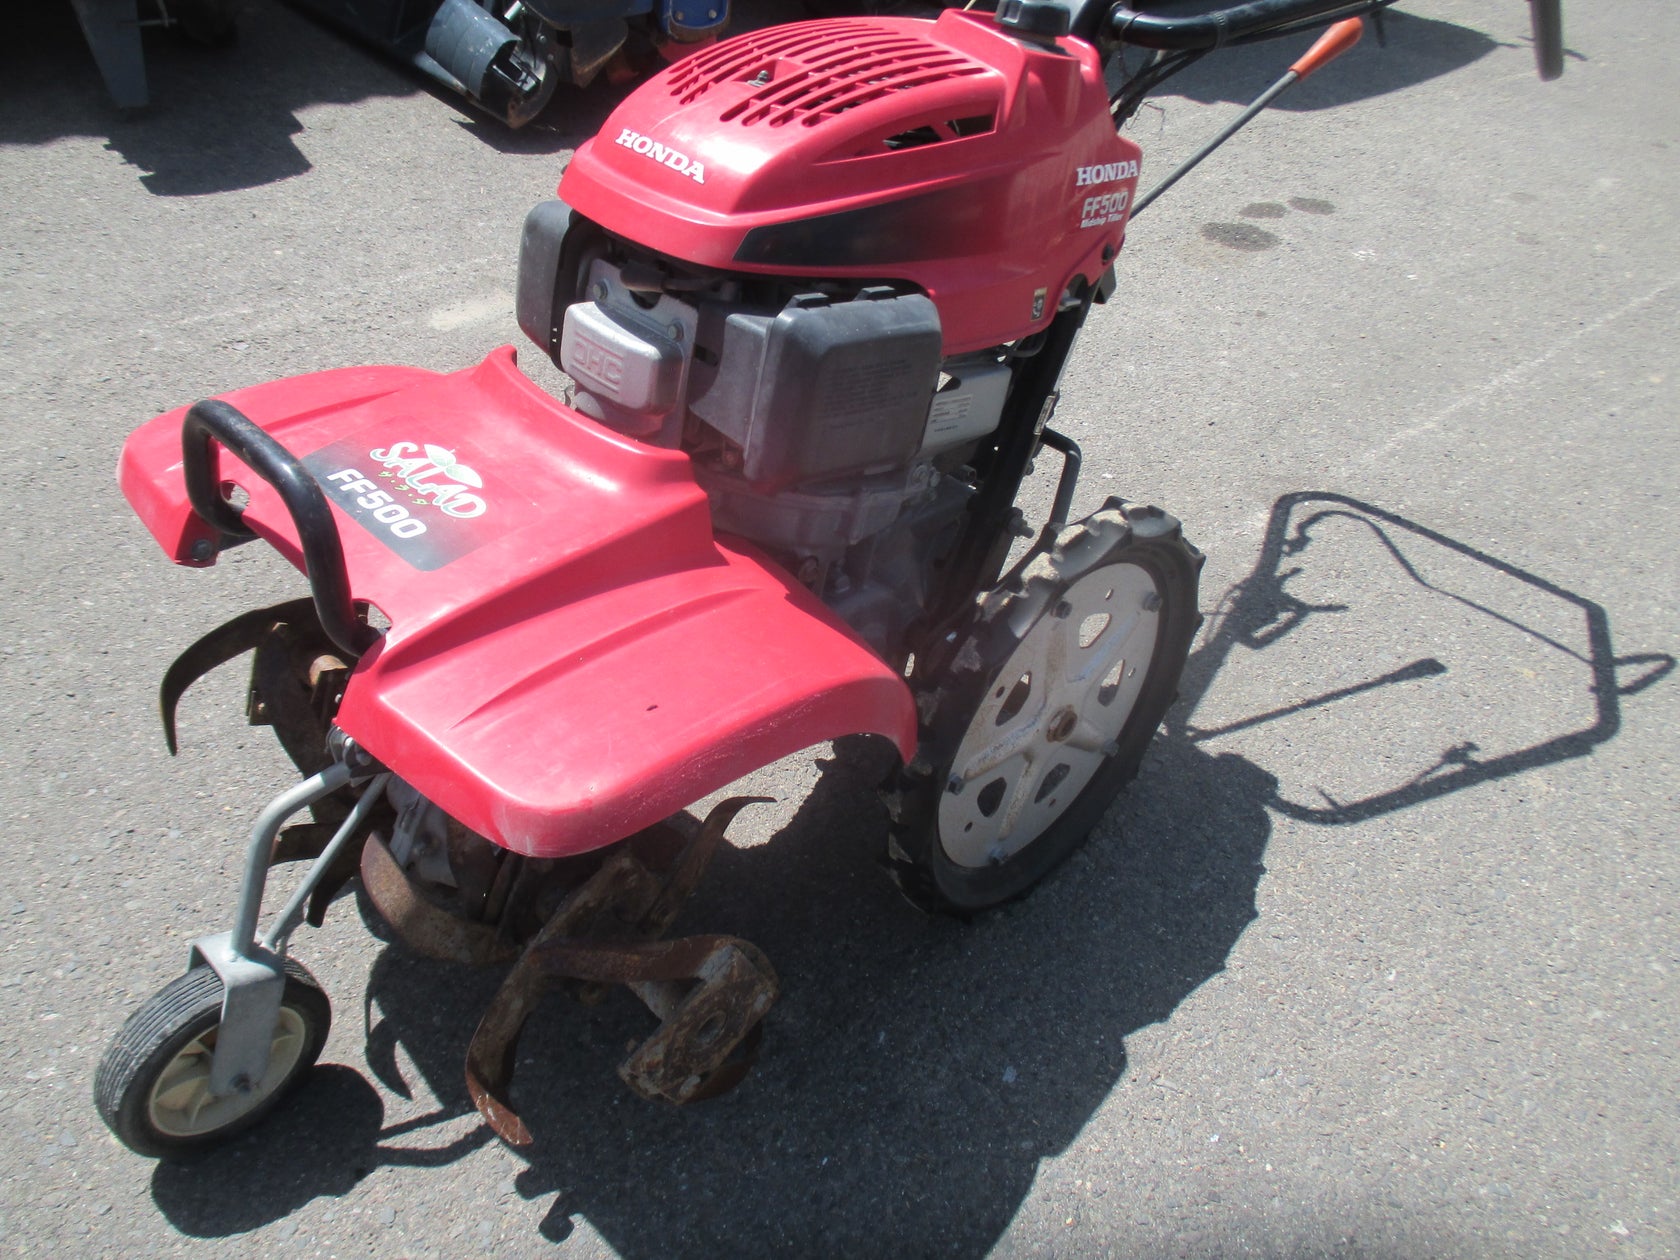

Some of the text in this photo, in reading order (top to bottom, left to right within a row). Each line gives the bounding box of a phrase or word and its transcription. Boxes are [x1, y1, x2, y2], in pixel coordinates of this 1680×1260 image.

[615, 128, 705, 185] HONDA
[1076, 160, 1138, 186] HONDA
[1082, 191, 1129, 219] FF500
[326, 468, 428, 539] FF500
[369, 441, 487, 519] SALAD
